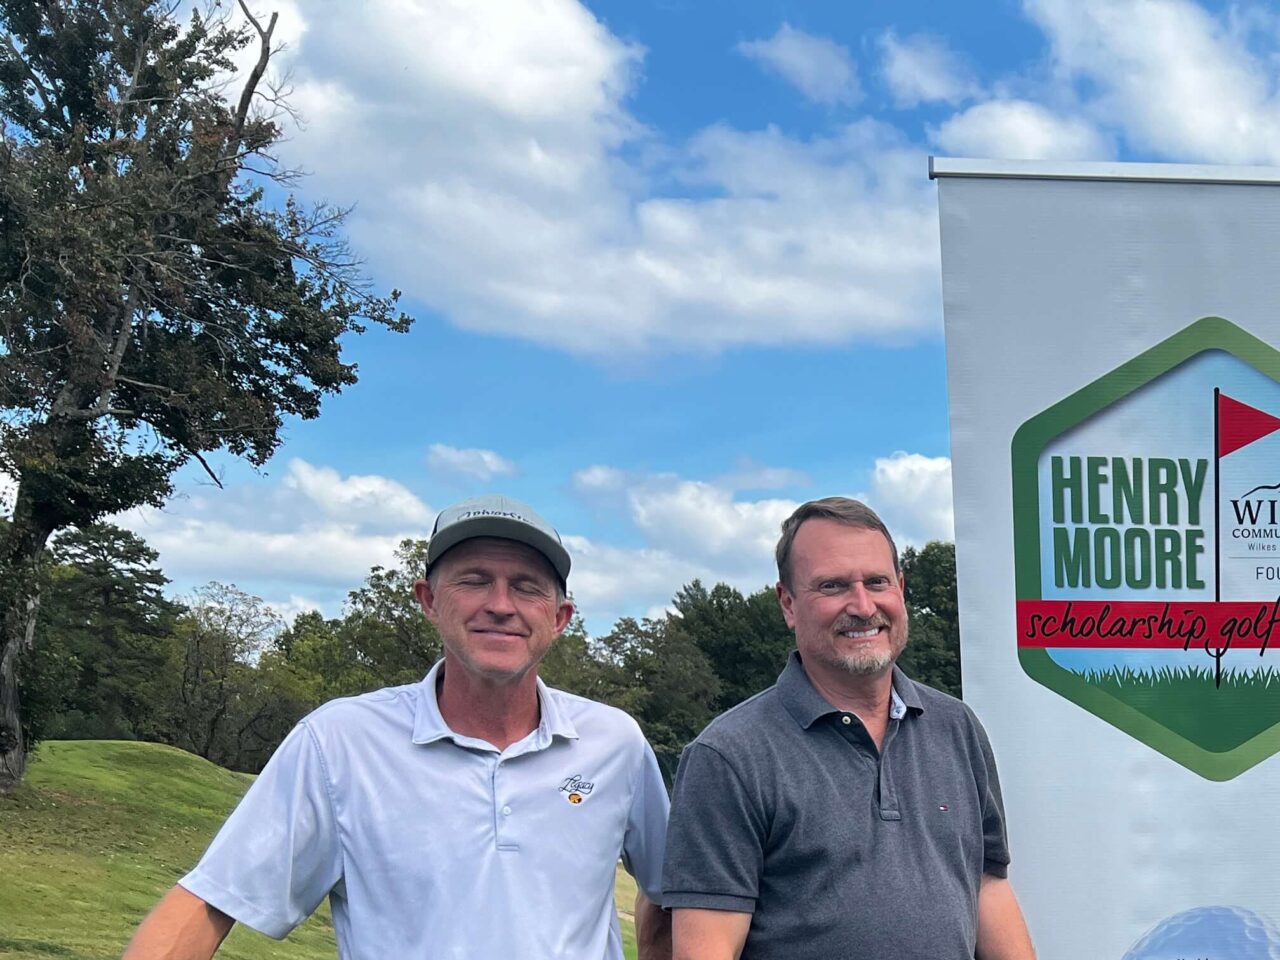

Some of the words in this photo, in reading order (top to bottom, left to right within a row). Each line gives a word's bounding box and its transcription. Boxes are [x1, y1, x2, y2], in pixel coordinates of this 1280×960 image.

[1051, 456, 1209, 525] HENRY
[1053, 527, 1205, 589] MOORE
[1247, 543, 1277, 551] Wilkes
[1026, 602, 1207, 651] scholarship
